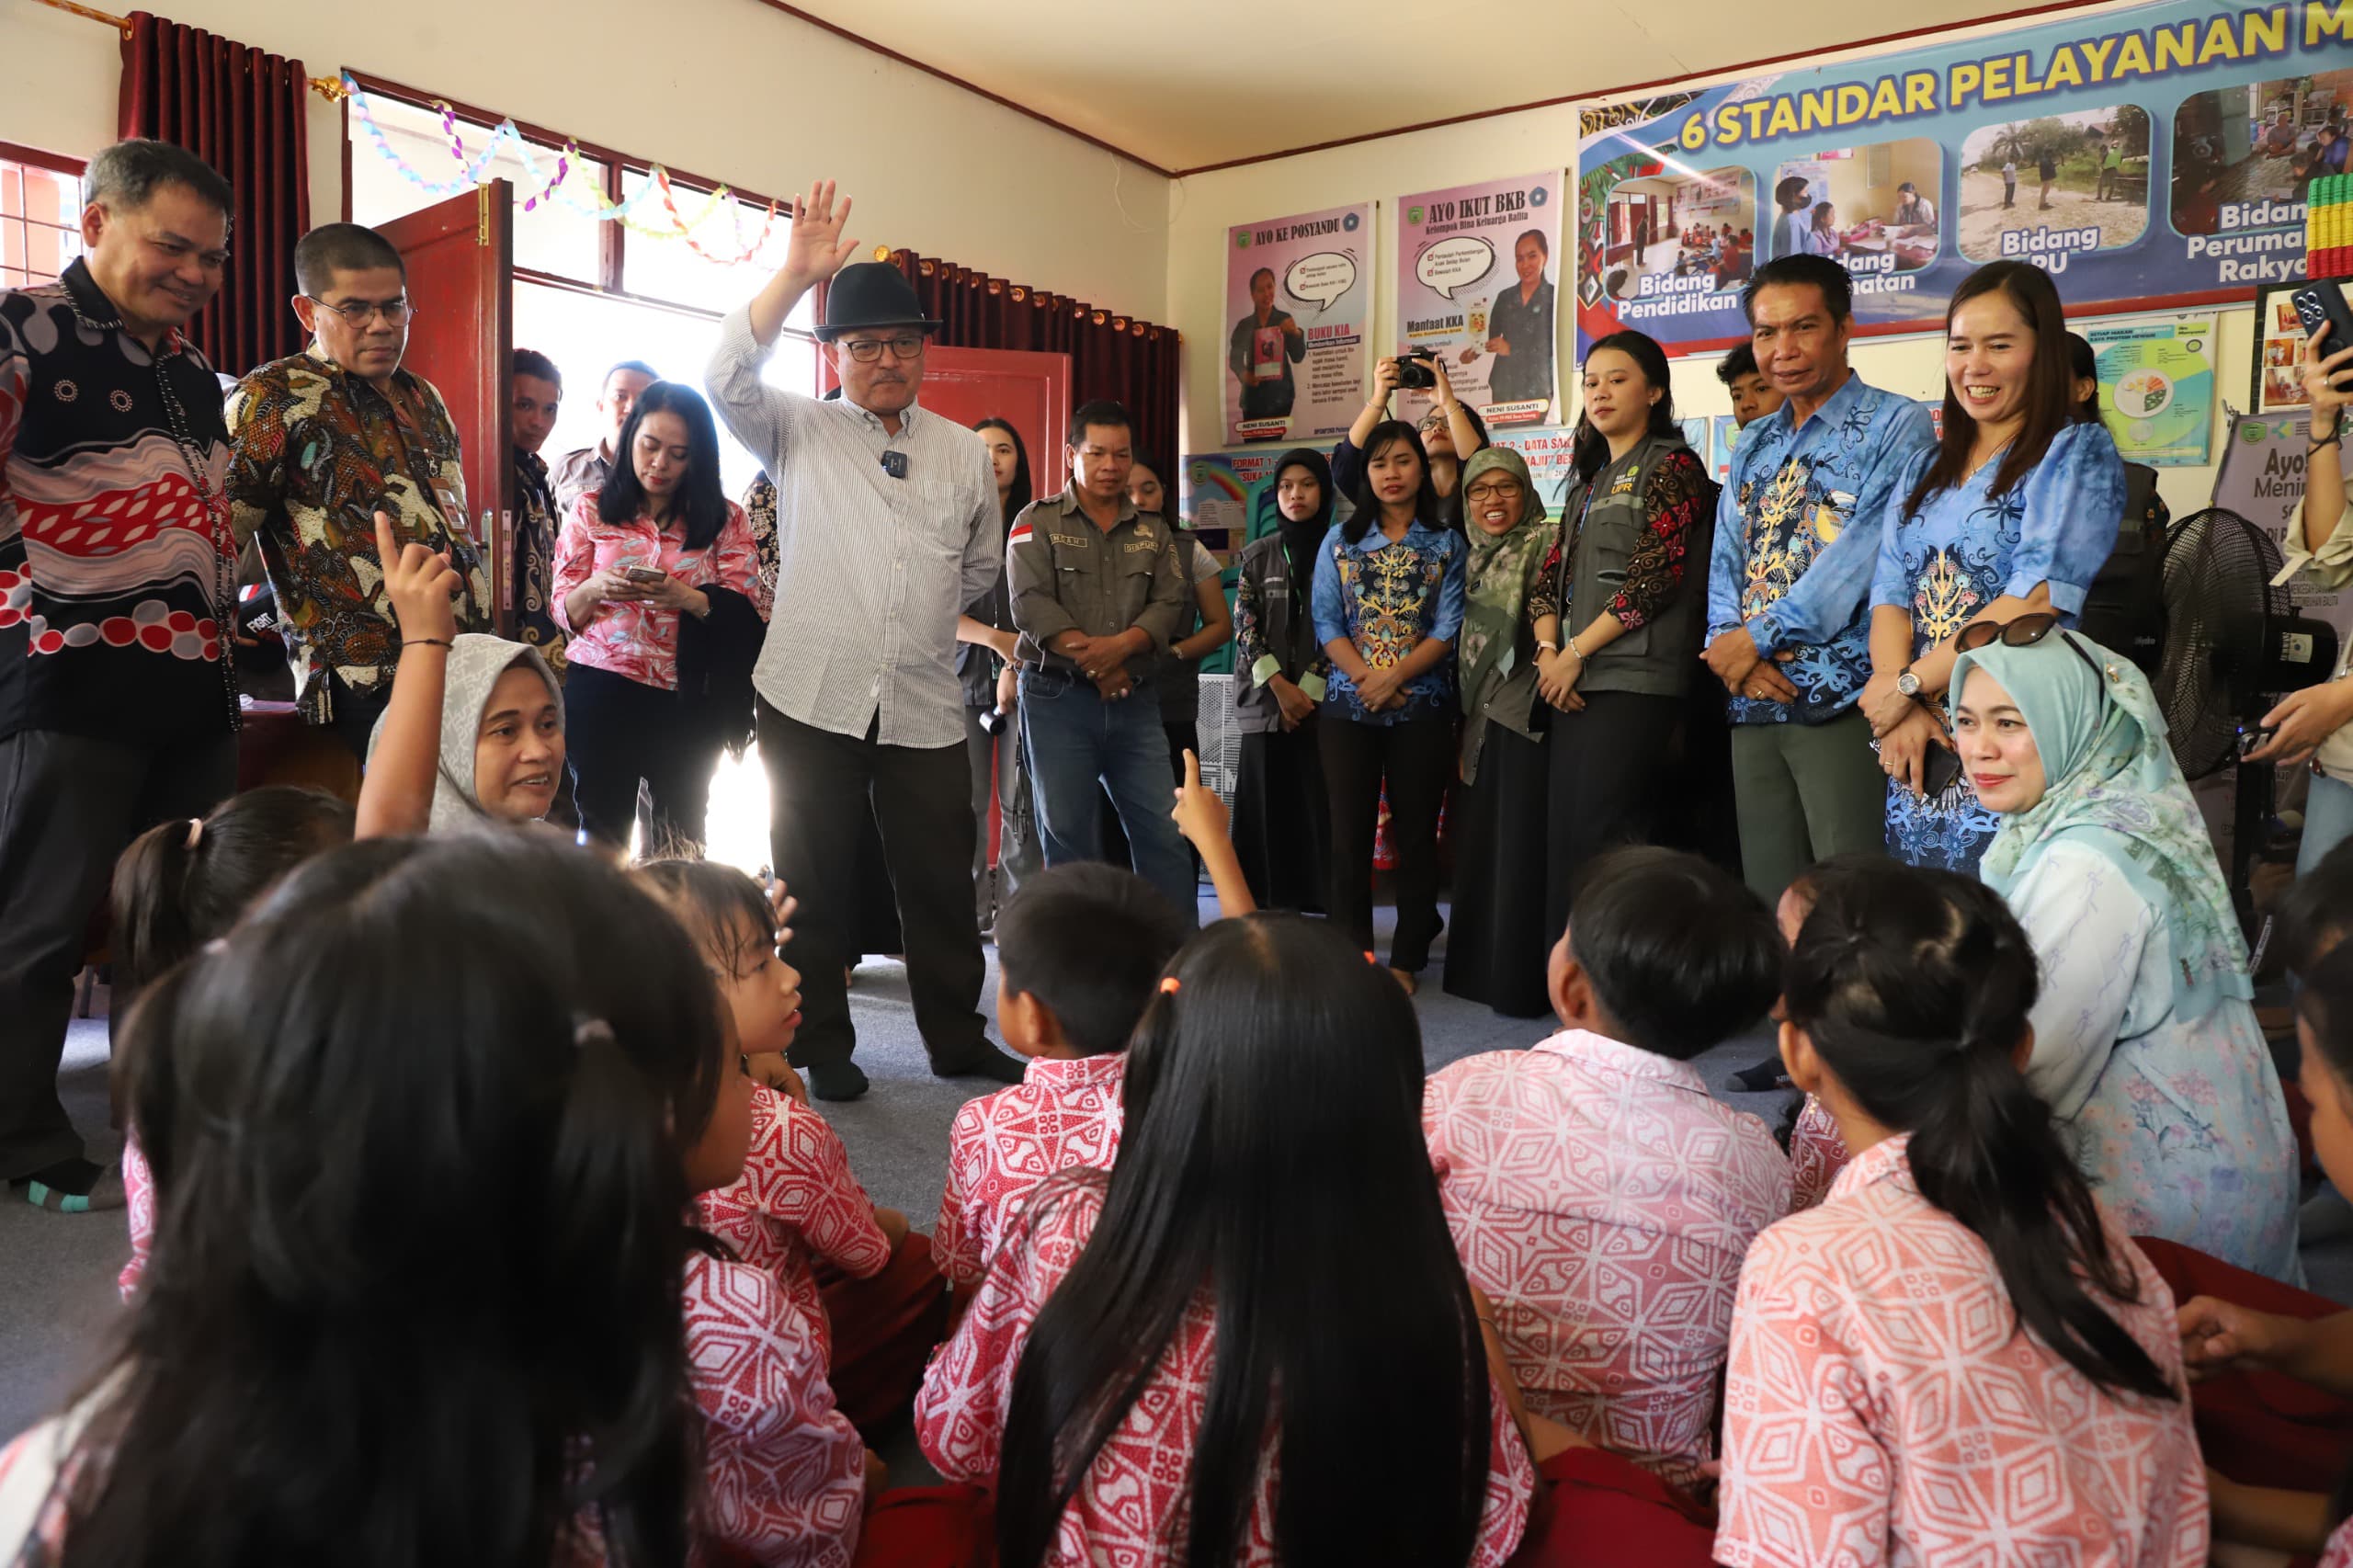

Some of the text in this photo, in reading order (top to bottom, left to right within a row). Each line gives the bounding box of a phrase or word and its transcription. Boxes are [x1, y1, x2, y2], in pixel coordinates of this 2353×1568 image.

[1681, 113, 1706, 150] 6
[1716, 73, 1937, 143] STANDAR
[1949, 8, 2286, 106] PELAYANAN
[1429, 191, 1525, 223] AYO IKUT BKB
[2221, 200, 2308, 228] Bidan
[1256, 219, 1339, 245] AYO KE POSYANDU
[1476, 215, 1506, 227] Keluarga
[2003, 229, 2098, 256] Bidang
[2188, 223, 2308, 258] Peruma
[2031, 253, 2067, 274] PU
[2220, 255, 2307, 282] Rakya
[1640, 274, 1716, 297] Bidang
[1618, 293, 1737, 320] Pendidikan
[1308, 324, 1350, 340] BUKU KIA
[1407, 314, 1463, 332] Manfaat KKA
[1506, 403, 1539, 412] SUSANTI
[1524, 438, 1548, 451] DATA
[1232, 458, 1264, 469] FORMAT
[1611, 483, 1633, 494] UPR
[246, 612, 274, 633] FIGHT
